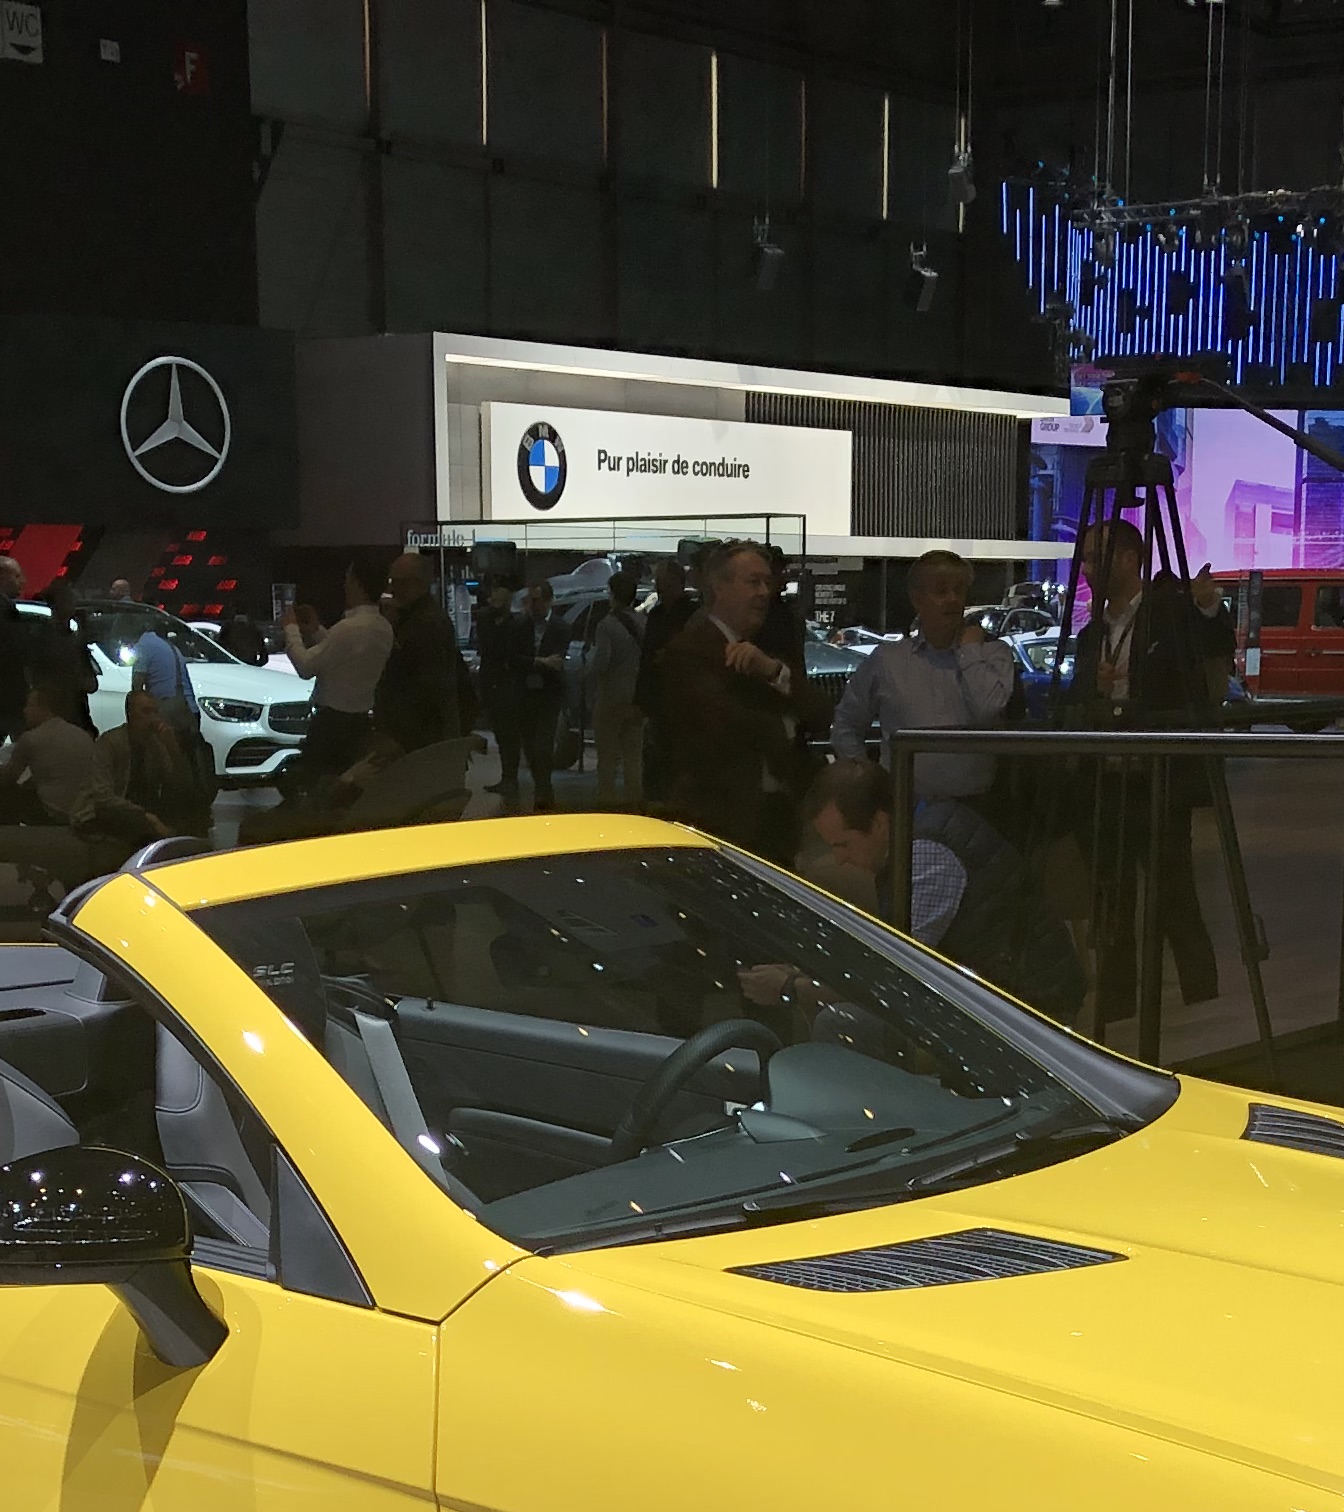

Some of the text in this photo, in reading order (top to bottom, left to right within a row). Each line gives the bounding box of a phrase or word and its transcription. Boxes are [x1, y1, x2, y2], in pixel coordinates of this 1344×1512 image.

[7, 8, 39, 37] WC
[597, 449, 751, 479] Pur plaisir de conduire
